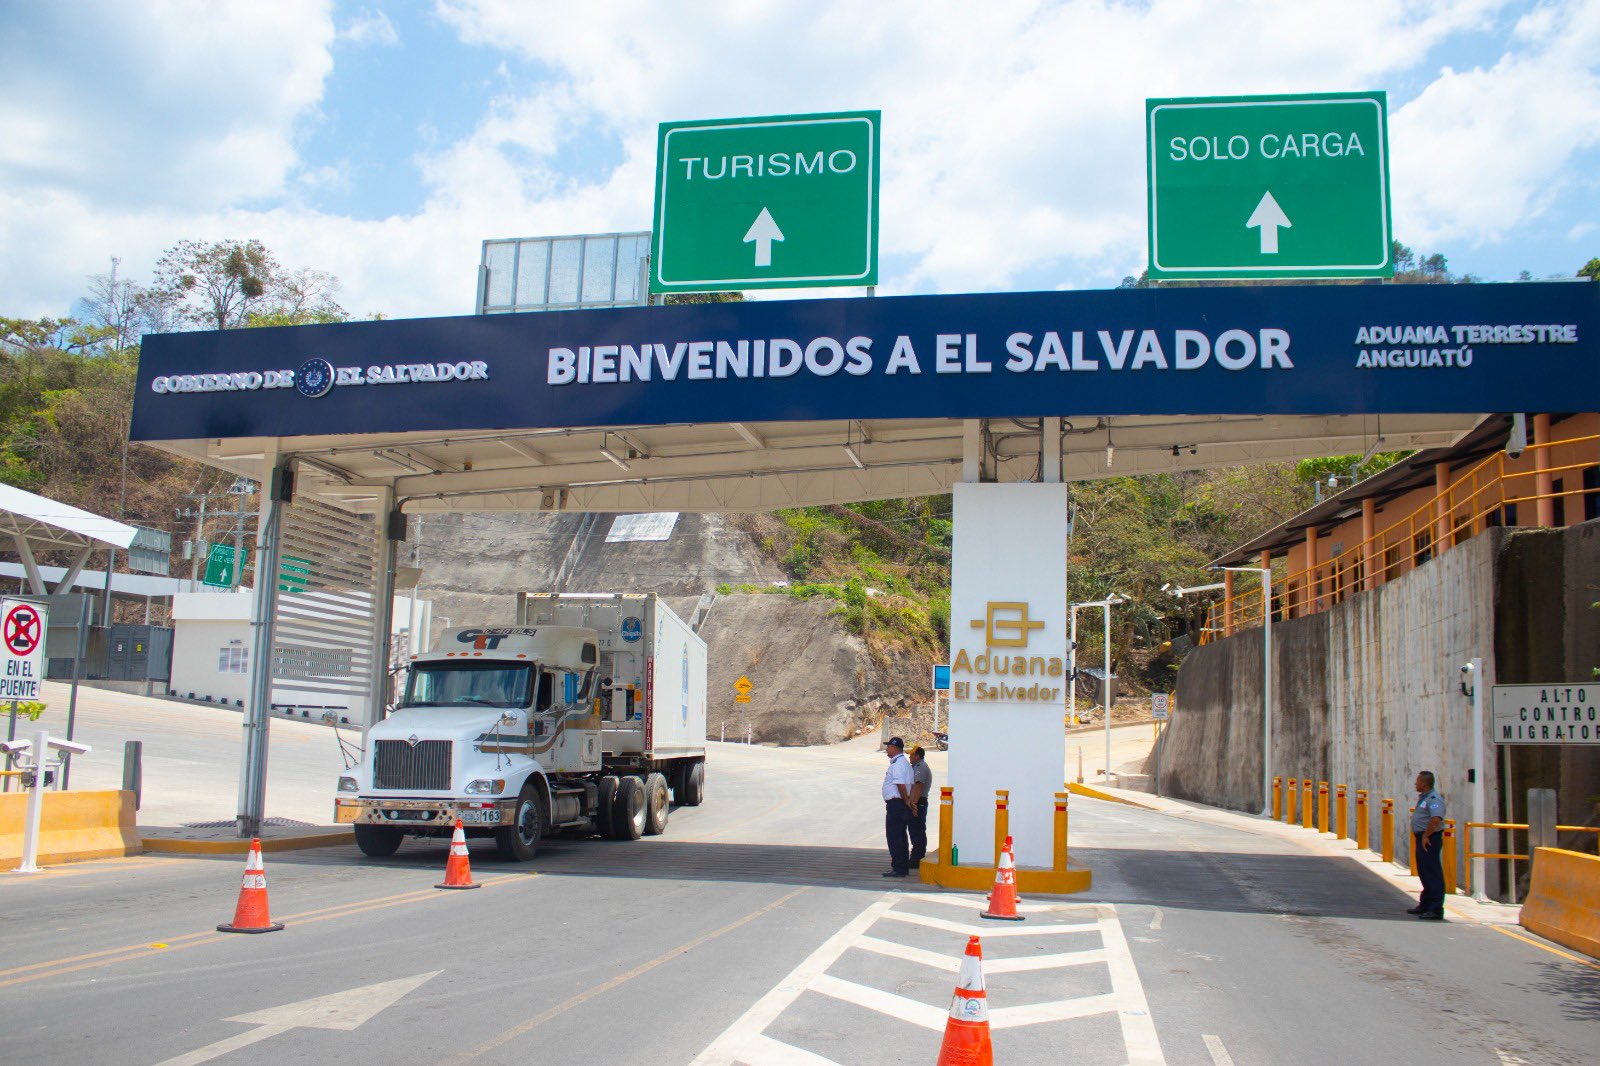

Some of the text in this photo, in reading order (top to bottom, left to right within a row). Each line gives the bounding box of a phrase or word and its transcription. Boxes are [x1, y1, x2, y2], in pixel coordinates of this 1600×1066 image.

[1169, 132, 1365, 161] SOLO CARGA
[678, 149, 857, 180] TURISMO
[1355, 324, 1579, 345] ADUANA TERRESTRE
[547, 328, 1295, 385] BIENVENIDOS A EL SALVADOR
[1356, 345, 1473, 368] ANGUIATÚ
[151, 360, 489, 394] GOBIERNO DE EL SALVADOR
[7, 660, 33, 677] EN EL
[952, 648, 1063, 677] Aduana
[0, 679, 37, 697] PUENTE
[954, 681, 1060, 701] El Salvador
[1541, 688, 1586, 703] ALTO
[1519, 706, 1596, 721] CONTRO
[482, 810, 500, 822] 163
